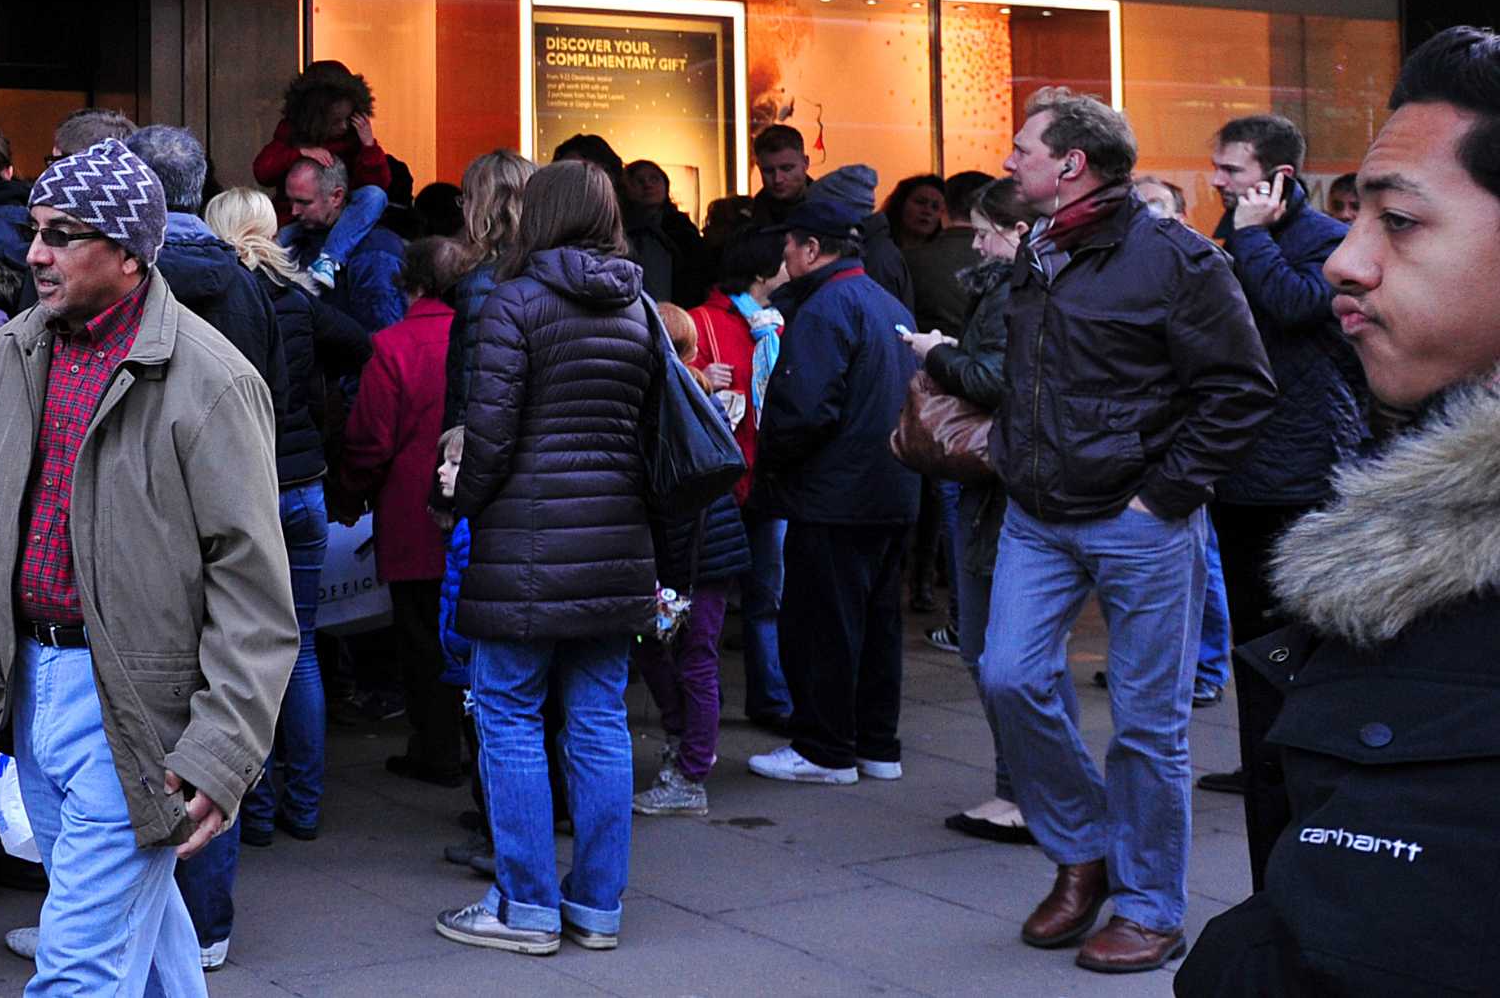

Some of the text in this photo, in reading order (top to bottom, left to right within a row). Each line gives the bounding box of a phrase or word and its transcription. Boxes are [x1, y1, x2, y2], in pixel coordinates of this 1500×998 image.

[546, 36, 651, 55] DISCOVER YOUR
[546, 52, 688, 72] COMPLIMENTARY GIFT
[1299, 827, 1424, 863] carhartt
